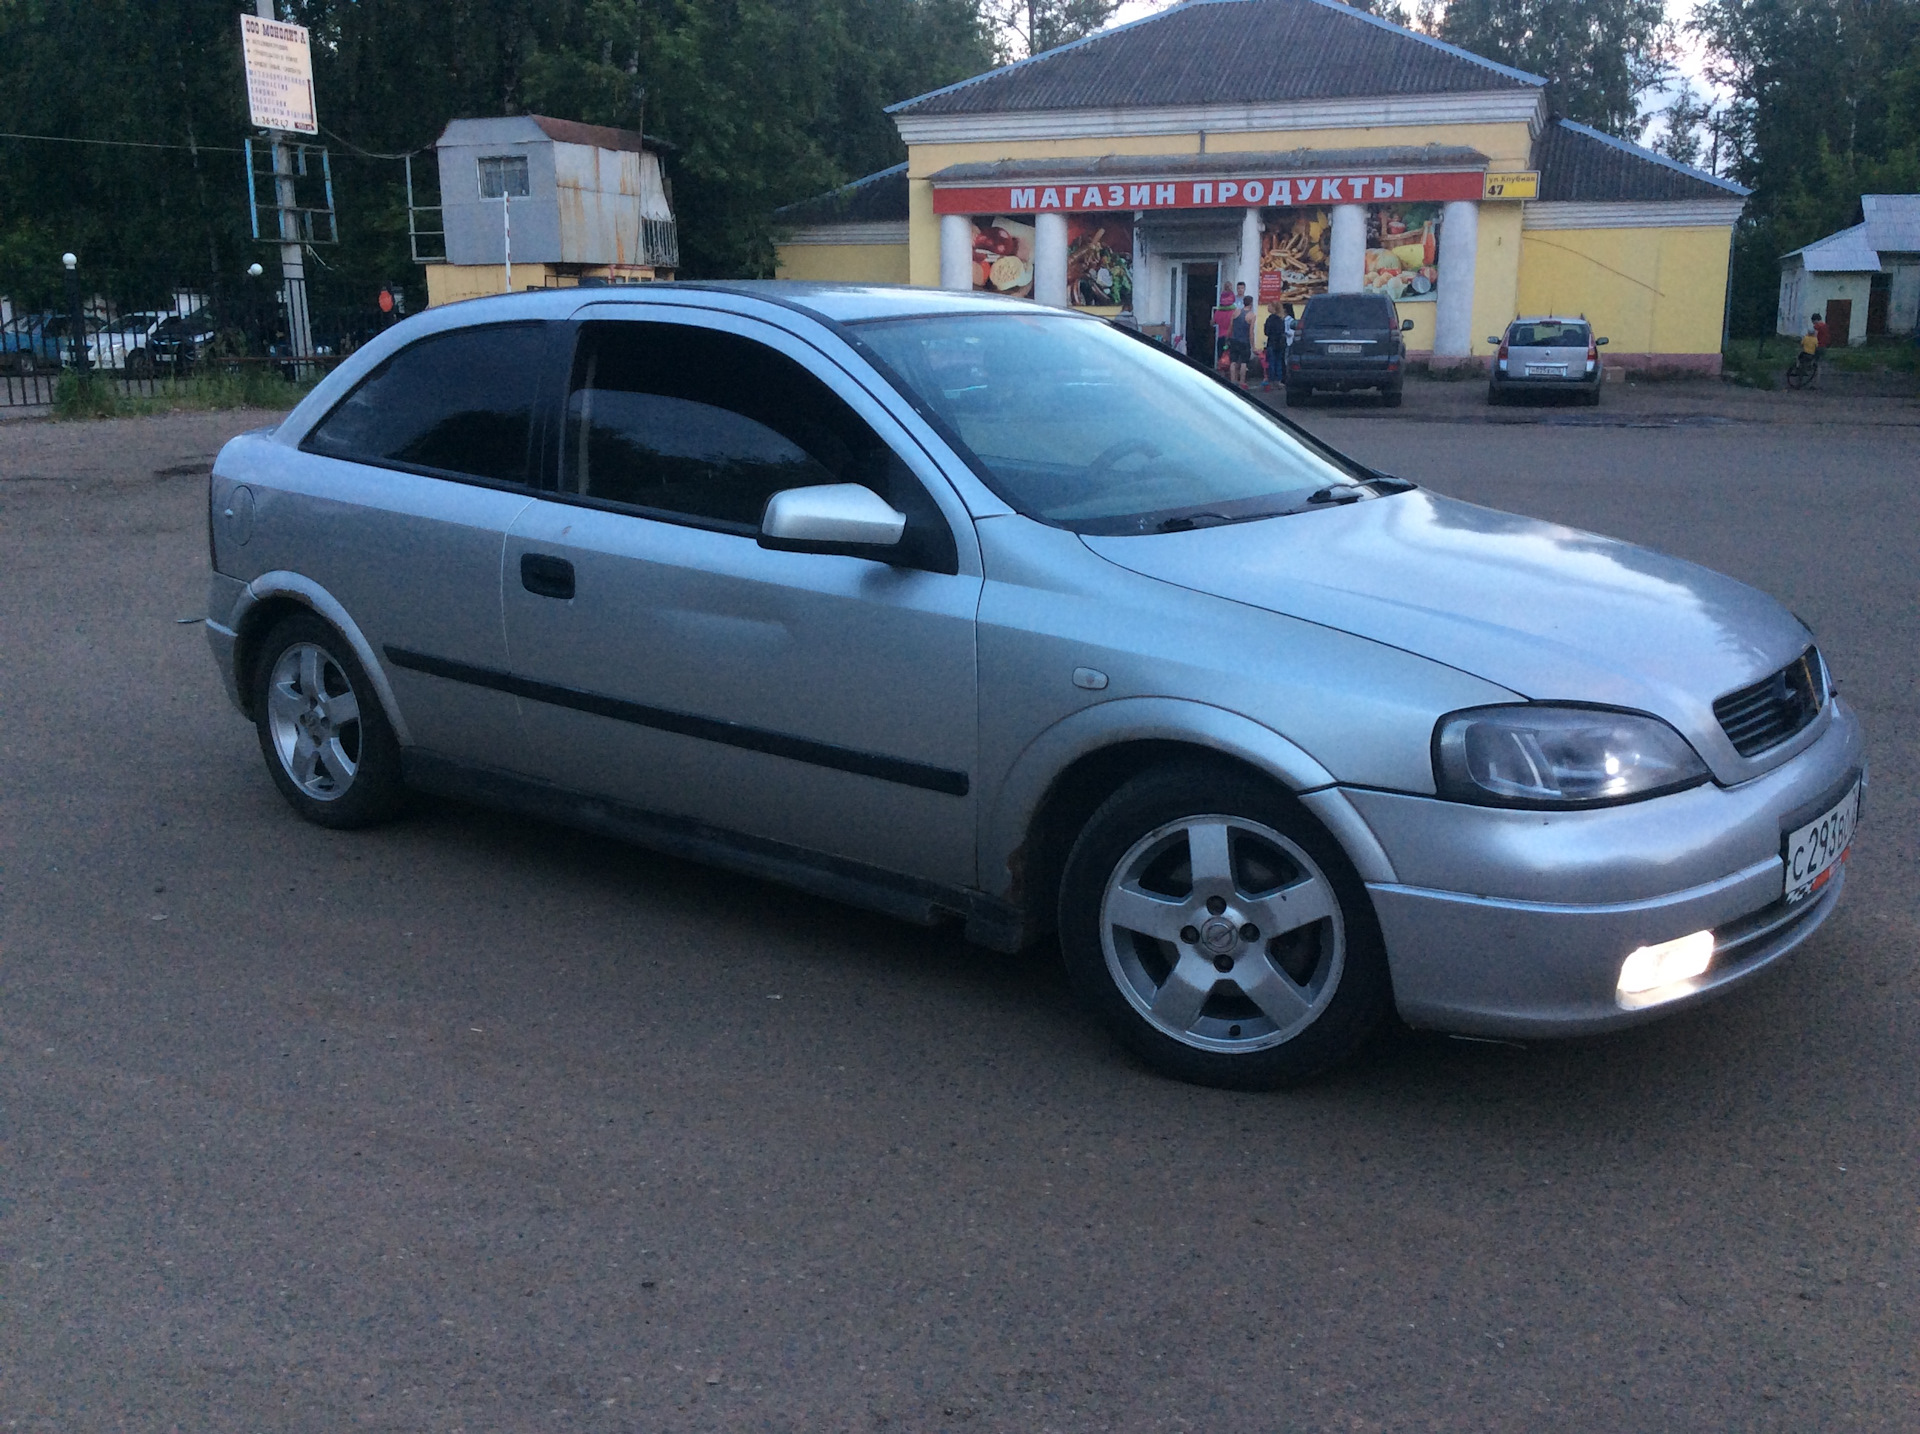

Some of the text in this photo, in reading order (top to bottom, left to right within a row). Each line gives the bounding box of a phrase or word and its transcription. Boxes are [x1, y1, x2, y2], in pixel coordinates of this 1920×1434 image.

[245, 20, 260, 34] ООО
[1010, 176, 1404, 208] МАГАЗИН ПРОДУКТЫ
[1488, 185, 1504, 195] 47
